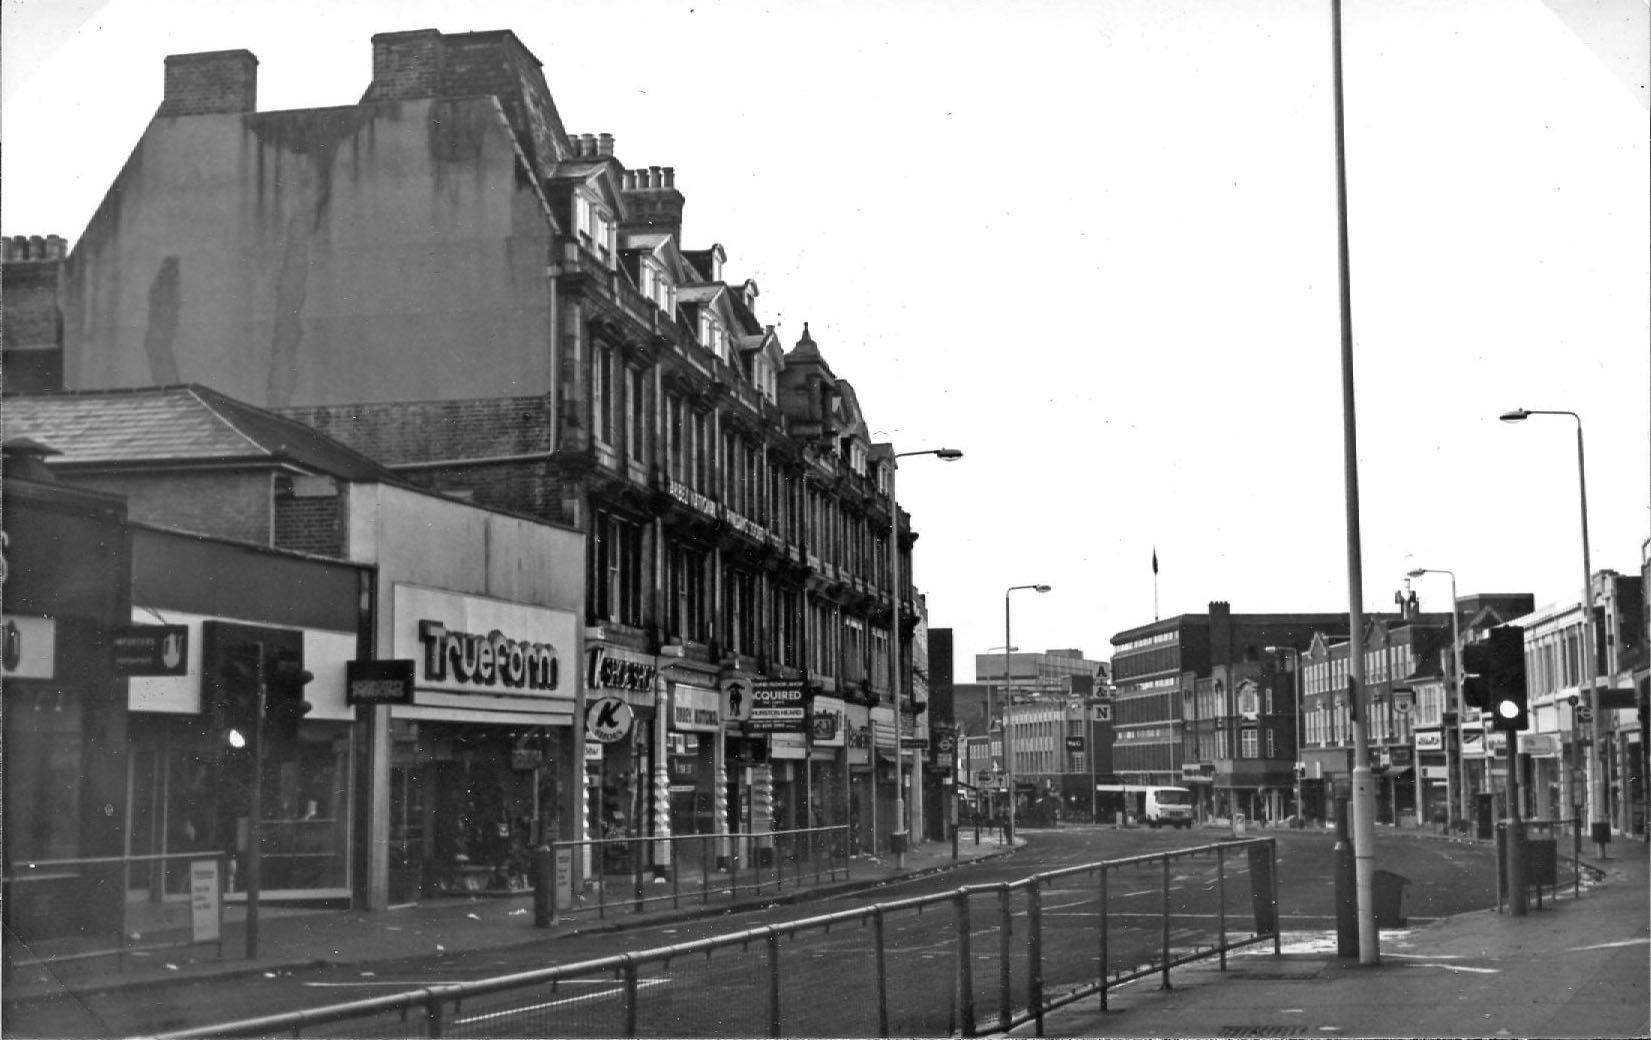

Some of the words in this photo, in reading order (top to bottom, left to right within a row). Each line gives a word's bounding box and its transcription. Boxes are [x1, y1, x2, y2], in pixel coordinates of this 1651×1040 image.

[1096, 665, 1107, 677] A
[752, 690, 801, 700] CQUIRED
[596, 701, 621, 728] K
[1096, 706, 1107, 719] N
